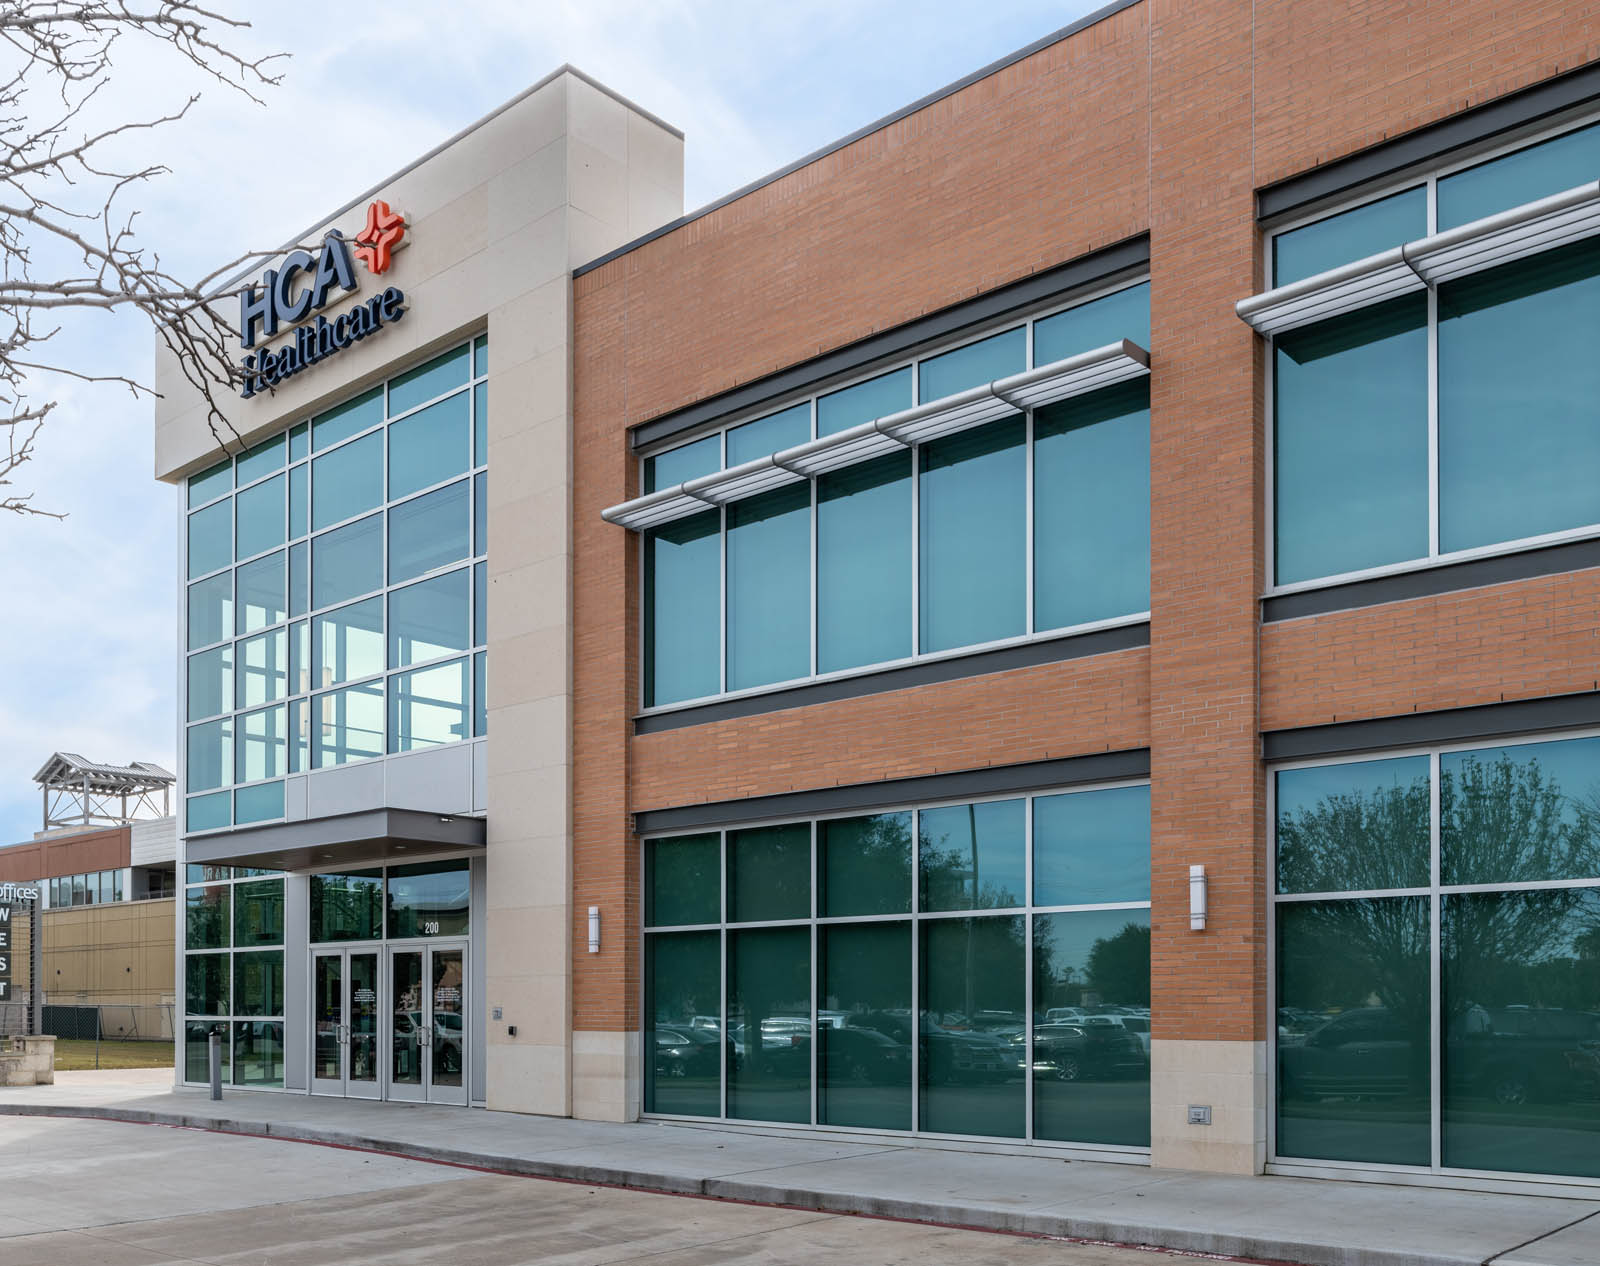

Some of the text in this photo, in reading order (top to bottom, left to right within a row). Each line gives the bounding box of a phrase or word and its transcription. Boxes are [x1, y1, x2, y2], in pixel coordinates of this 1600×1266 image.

[240, 228, 358, 349] HCA
[240, 286, 405, 399] Healthcare
[424, 921, 440, 934] 200
